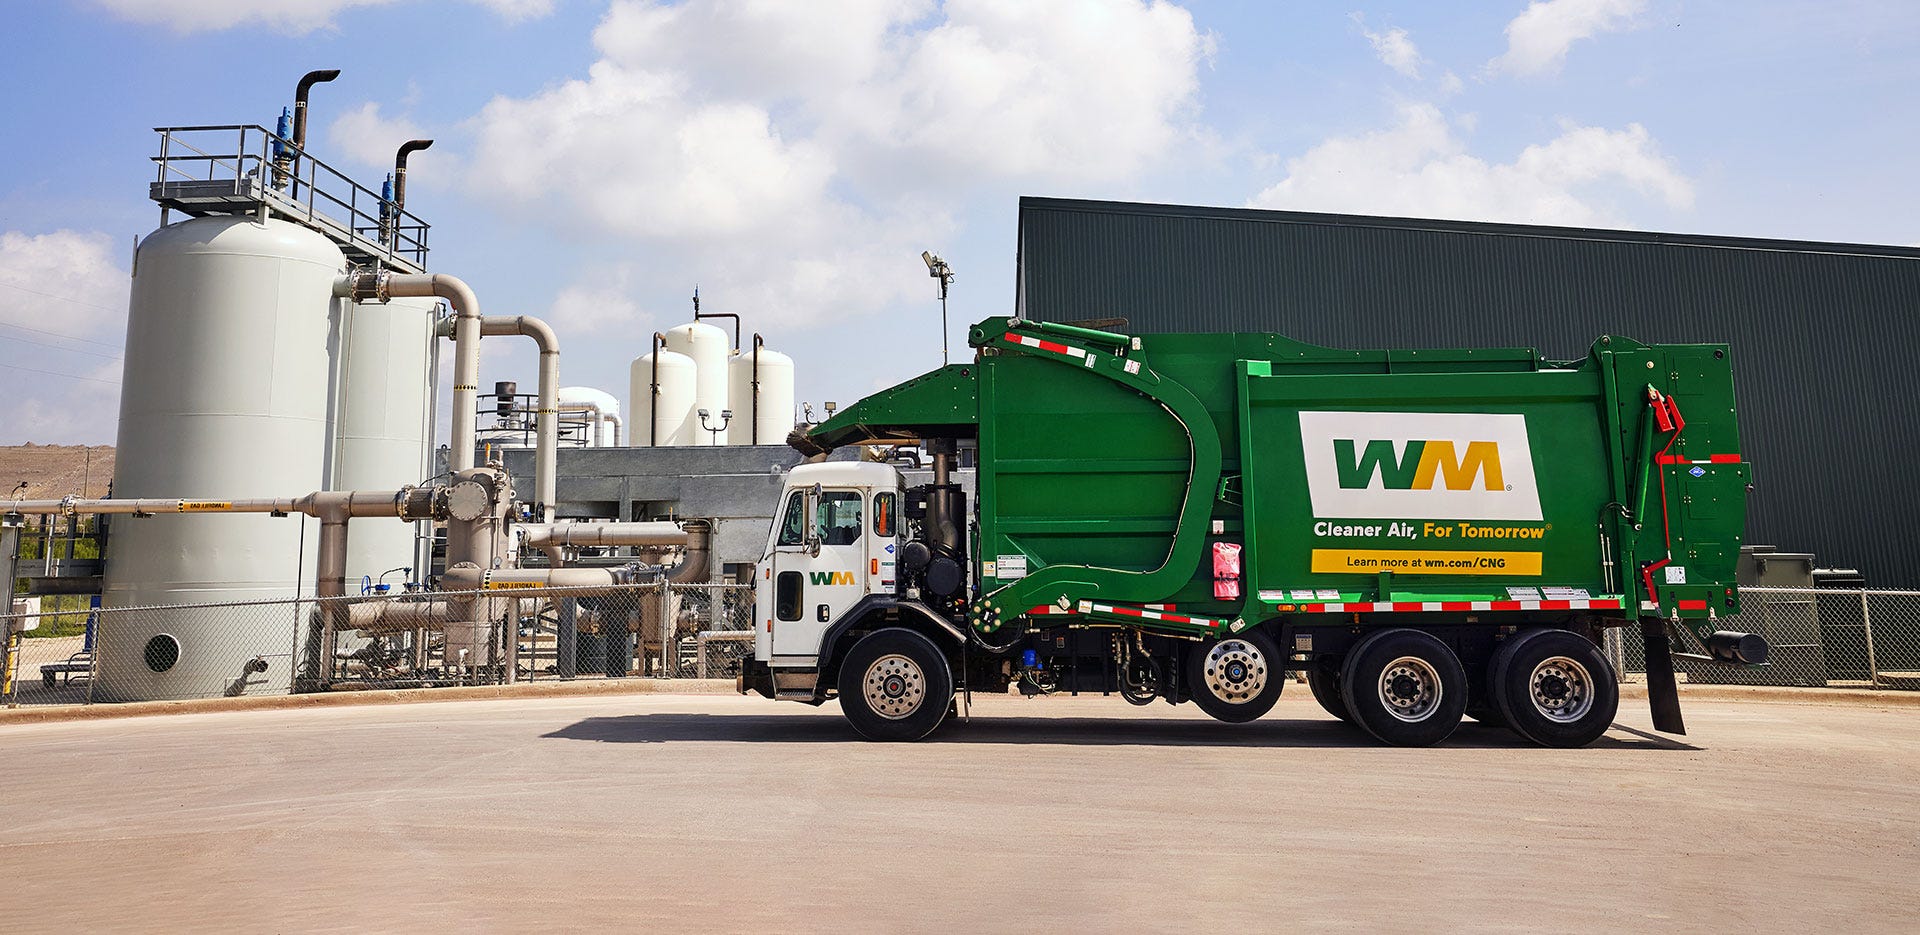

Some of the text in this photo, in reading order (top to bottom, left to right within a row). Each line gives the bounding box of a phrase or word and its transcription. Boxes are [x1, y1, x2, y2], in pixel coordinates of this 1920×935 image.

[1333, 439, 1505, 492] WM
[1314, 522, 1382, 537] Cleaner
[1387, 522, 1418, 540] Air,
[1423, 522, 1453, 538] For
[1347, 556, 1506, 569] Learn more at wm.com/CNG
[809, 571, 856, 586] WM
